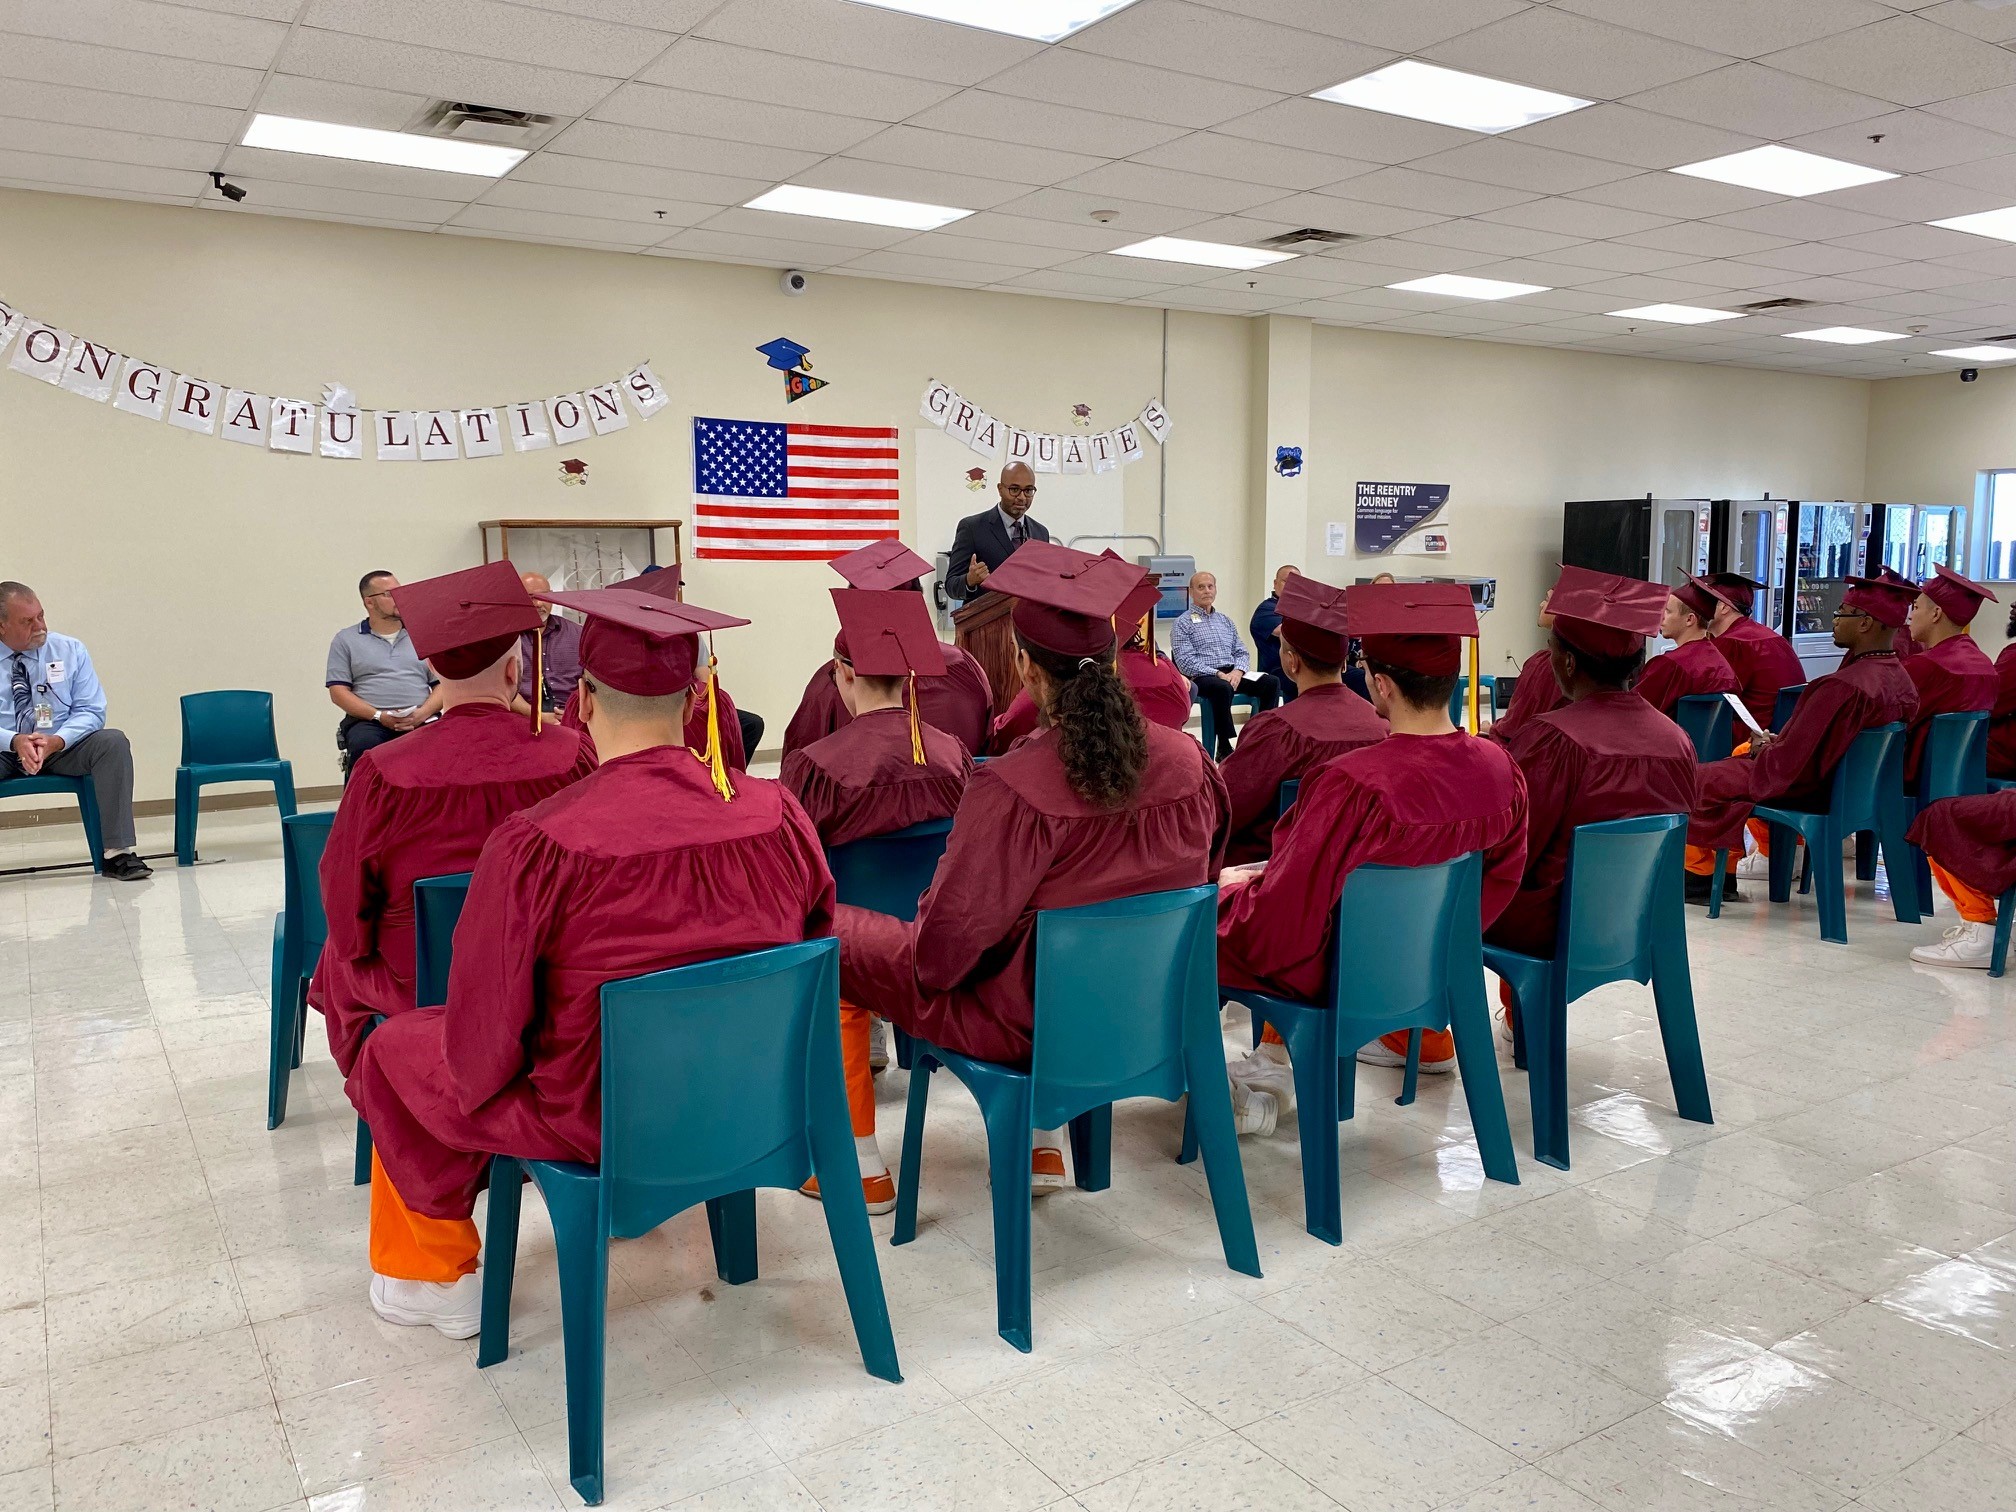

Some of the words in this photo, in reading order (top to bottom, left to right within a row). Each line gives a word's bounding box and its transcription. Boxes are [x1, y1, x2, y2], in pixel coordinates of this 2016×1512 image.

[928, 388, 1165, 463] GRADUATES
[1358, 485, 1376, 495] THE
[1377, 485, 1416, 496] REENTRY
[1357, 497, 1399, 507] JOURNEY
